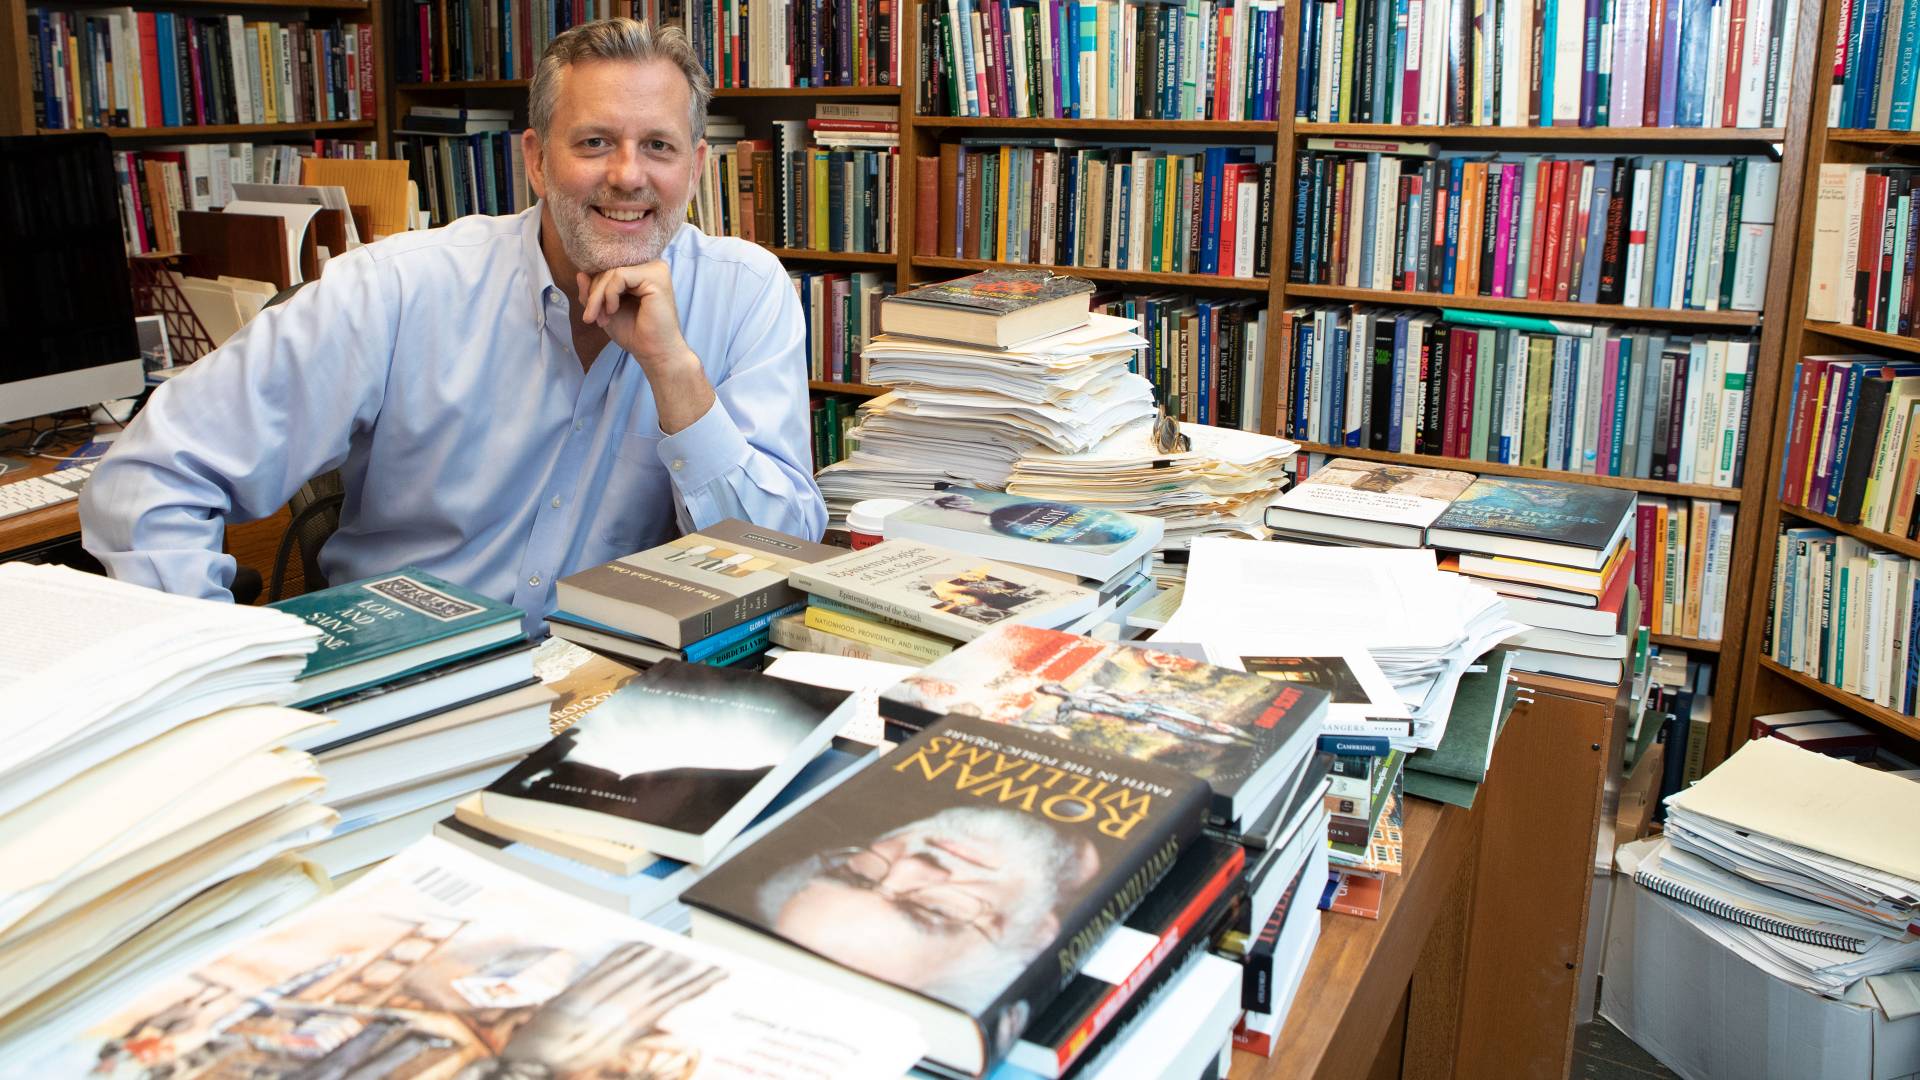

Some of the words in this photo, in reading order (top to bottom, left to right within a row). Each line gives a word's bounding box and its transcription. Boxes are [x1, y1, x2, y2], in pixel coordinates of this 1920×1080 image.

[1168, 8, 1178, 32] RELIGION
[1168, 33, 1177, 44] and
[1365, 24, 1374, 54] CRITIQUE
[1408, 32, 1418, 64] THINGS
[1157, 38, 1165, 69] RELIGIOUS
[1167, 45, 1176, 64] MORAL
[1365, 55, 1372, 63] OF
[1768, 37, 1779, 82] DISPLACEMENT
[1844, 33, 1860, 80] NARRATIVE
[1166, 65, 1175, 87] REASON
[1364, 64, 1372, 102] MODERNITY
[1765, 89, 1774, 116] POLITICS
[1300, 156, 1310, 176] SANDEL
[1192, 184, 1200, 212] MORAL
[1297, 179, 1310, 225] DEMOCRACY'S
[1421, 187, 1431, 232] SITUATING
[1510, 195, 1519, 224] Citizenship
[1191, 213, 1200, 248] WISDOM
[1489, 212, 1497, 235] American
[1509, 225, 1517, 239] After
[1848, 214, 1859, 247] HANNAH
[1294, 227, 1305, 264] DISCONTENT
[1420, 235, 1429, 250] THE
[1508, 239, 1516, 265] Liberalism
[1419, 253, 1429, 273] SELF
[1544, 235, 1558, 279] Democracy
[1845, 248, 1856, 280] ARENDT
[1745, 276, 1756, 299] politics
[1180, 329, 1188, 342] The
[1180, 343, 1188, 374] Christian
[1220, 352, 1228, 367] TIME
[1420, 346, 1430, 380] RADICAL
[1434, 343, 1443, 377] POLITICAL
[1465, 354, 1473, 374] Building
[1179, 374, 1187, 393] Moral
[1220, 369, 1228, 402] EXPOSURE
[1303, 367, 1311, 399] POLITICAL
[1365, 366, 1373, 393] PUBLIC
[1495, 363, 1504, 389] Political
[1745, 370, 1753, 384] THE
[1847, 371, 1857, 397] KANT'S
[1179, 394, 1187, 414] Vision
[1432, 380, 1441, 406] THEORY
[1616, 386, 1625, 412] VIRTUES
[1743, 386, 1752, 407] IRONY
[1362, 394, 1371, 424] REASON
[1416, 381, 1427, 431] DEMOCRACY
[1430, 407, 1440, 430] TODAY
[1493, 390, 1502, 433] Hermeneutics
[1558, 401, 1567, 425] Thought
[1842, 399, 1853, 422] MORAL
[1885, 406, 1895, 428] Perpetual
[1709, 402, 1718, 444] LIBERALISM
[1740, 417, 1749, 433] FREE
[1612, 418, 1622, 454] LIBERALISM
[1700, 422, 1709, 450] SOCIETY
[1737, 433, 1747, 456] SPEECH
[1835, 424, 1849, 464] TELEOLOGY
[1882, 429, 1891, 443] Peace
[1556, 440, 1564, 461] Practice
[1879, 452, 1887, 465] Other
[1875, 465, 1885, 481] Essays
[1667, 519, 1676, 550] AUTHORITY
[827, 547, 927, 580] Epistemologies
[894, 553, 938, 572] South
[1666, 553, 1675, 579] RICHARD
[1716, 533, 1731, 576] DEBATING
[1785, 534, 1797, 577] PERSONAL
[1823, 560, 1832, 576] WHAT
[1664, 580, 1673, 604] SENNETT
[1823, 577, 1831, 591] DOES
[357, 600, 406, 619] LOVE
[839, 590, 885, 612] Epistemologies
[891, 606, 903, 616] the
[902, 609, 922, 623] South
[1781, 581, 1793, 621] IDENTITY
[1822, 598, 1830, 608] ALL
[305, 611, 356, 633] SAINT
[335, 609, 377, 626] AND
[749, 619, 768, 633] GLOBAL
[1821, 608, 1830, 629] MEAN?
[814, 616, 857, 635] NATIONHOOD,
[858, 629, 897, 646] PROVIDENCE,
[898, 639, 912, 649] AND
[913, 643, 940, 657] WITNESS
[710, 697, 726, 706] OF
[943, 729, 1001, 752] SQUARE
[1337, 742, 1379, 751] CAMBRIDGE
[1003, 747, 1059, 767] PUBLIC
[1062, 761, 1093, 777] THE
[920, 736, 1152, 819] WILLIAMS
[1094, 769, 1120, 783] IN
[1127, 777, 1173, 799] FAITH
[892, 757, 1144, 840] ROWAN
[1057, 905, 1116, 973] ROWAN
[1115, 835, 1180, 923] WILLIAMS
